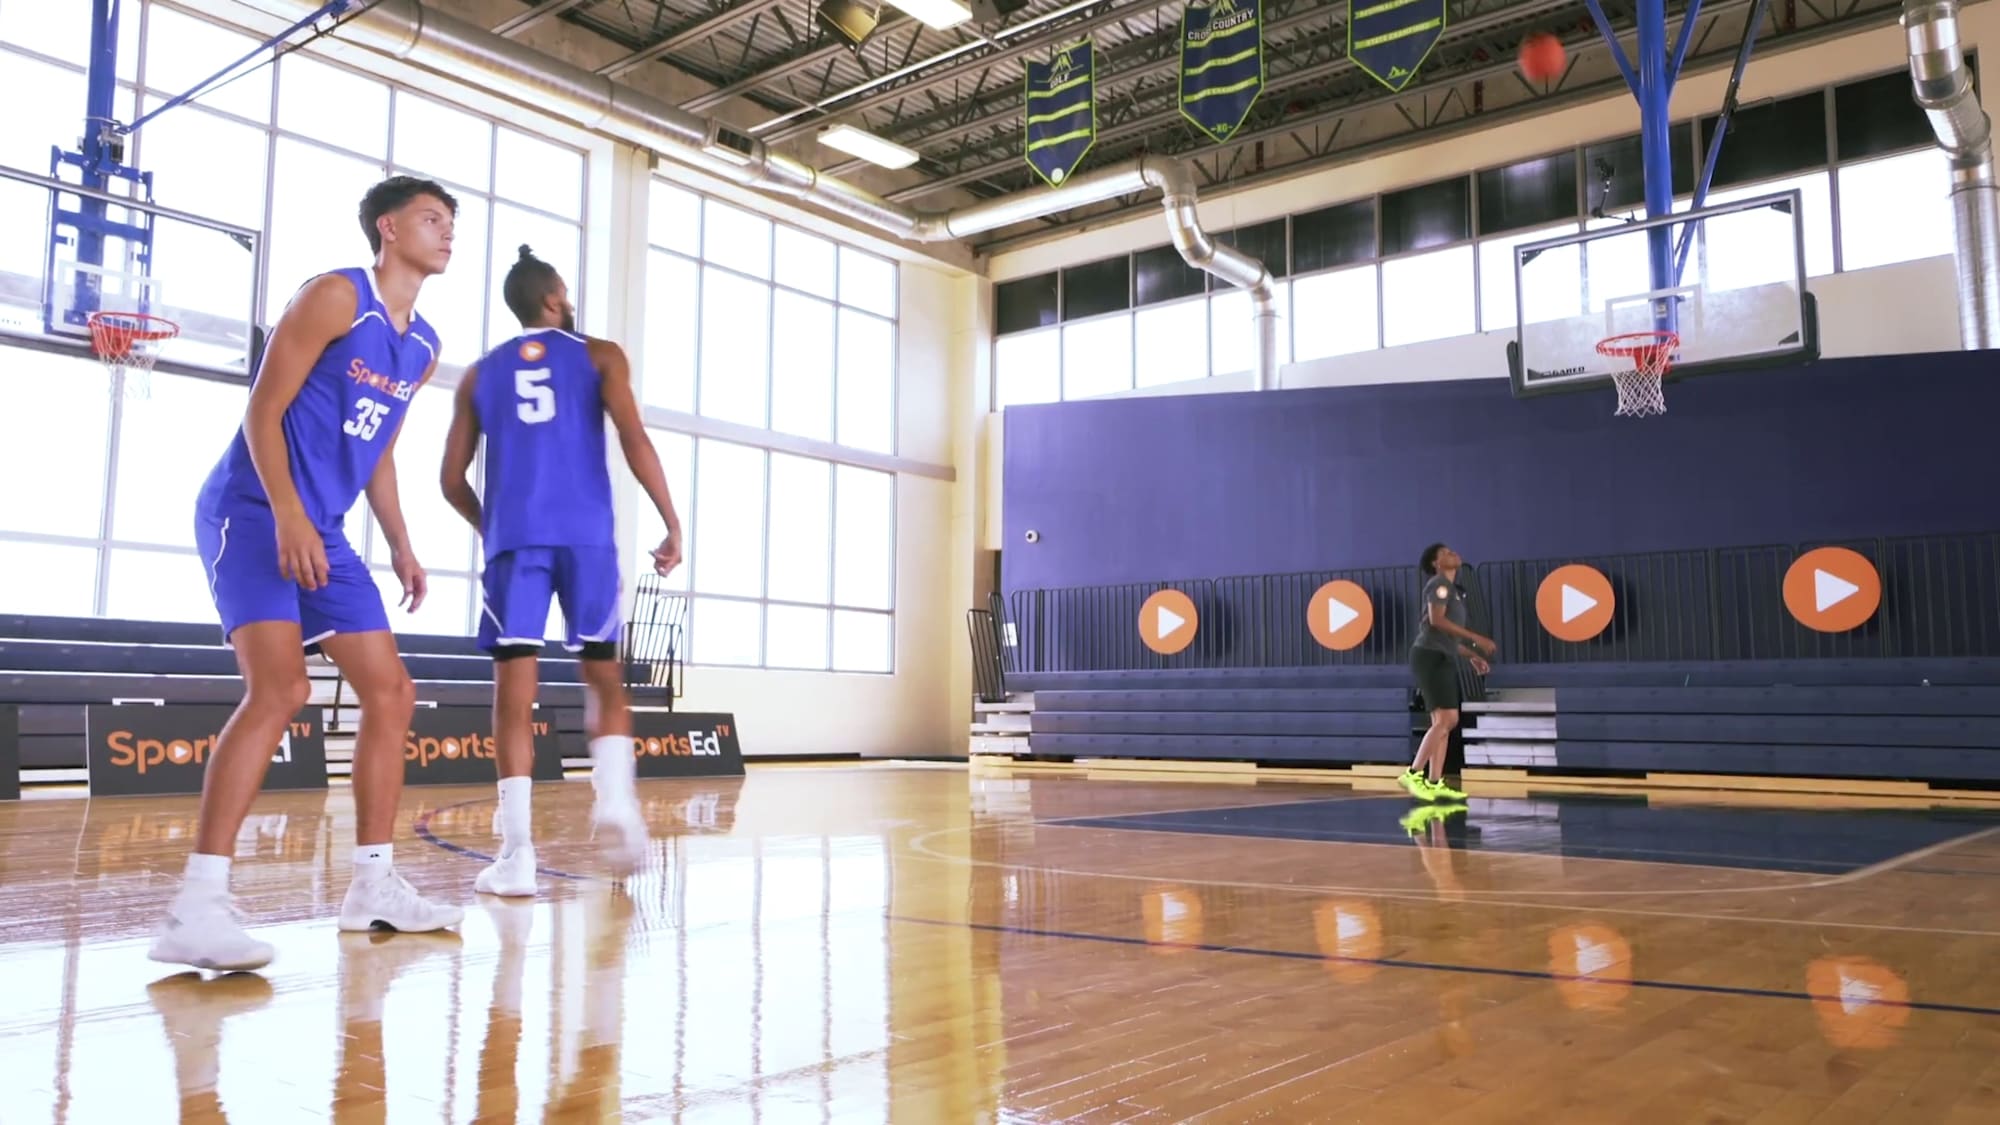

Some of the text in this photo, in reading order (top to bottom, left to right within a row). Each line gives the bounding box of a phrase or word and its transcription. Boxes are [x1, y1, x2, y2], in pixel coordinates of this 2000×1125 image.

[1212, 8, 1254, 31] COUNTRY
[515, 368, 556, 424] 5
[342, 397, 390, 442] 35
[107, 722, 311, 774] Sportd TV
[404, 729, 498, 767] Sports
[633, 724, 729, 759] portsEd TV
